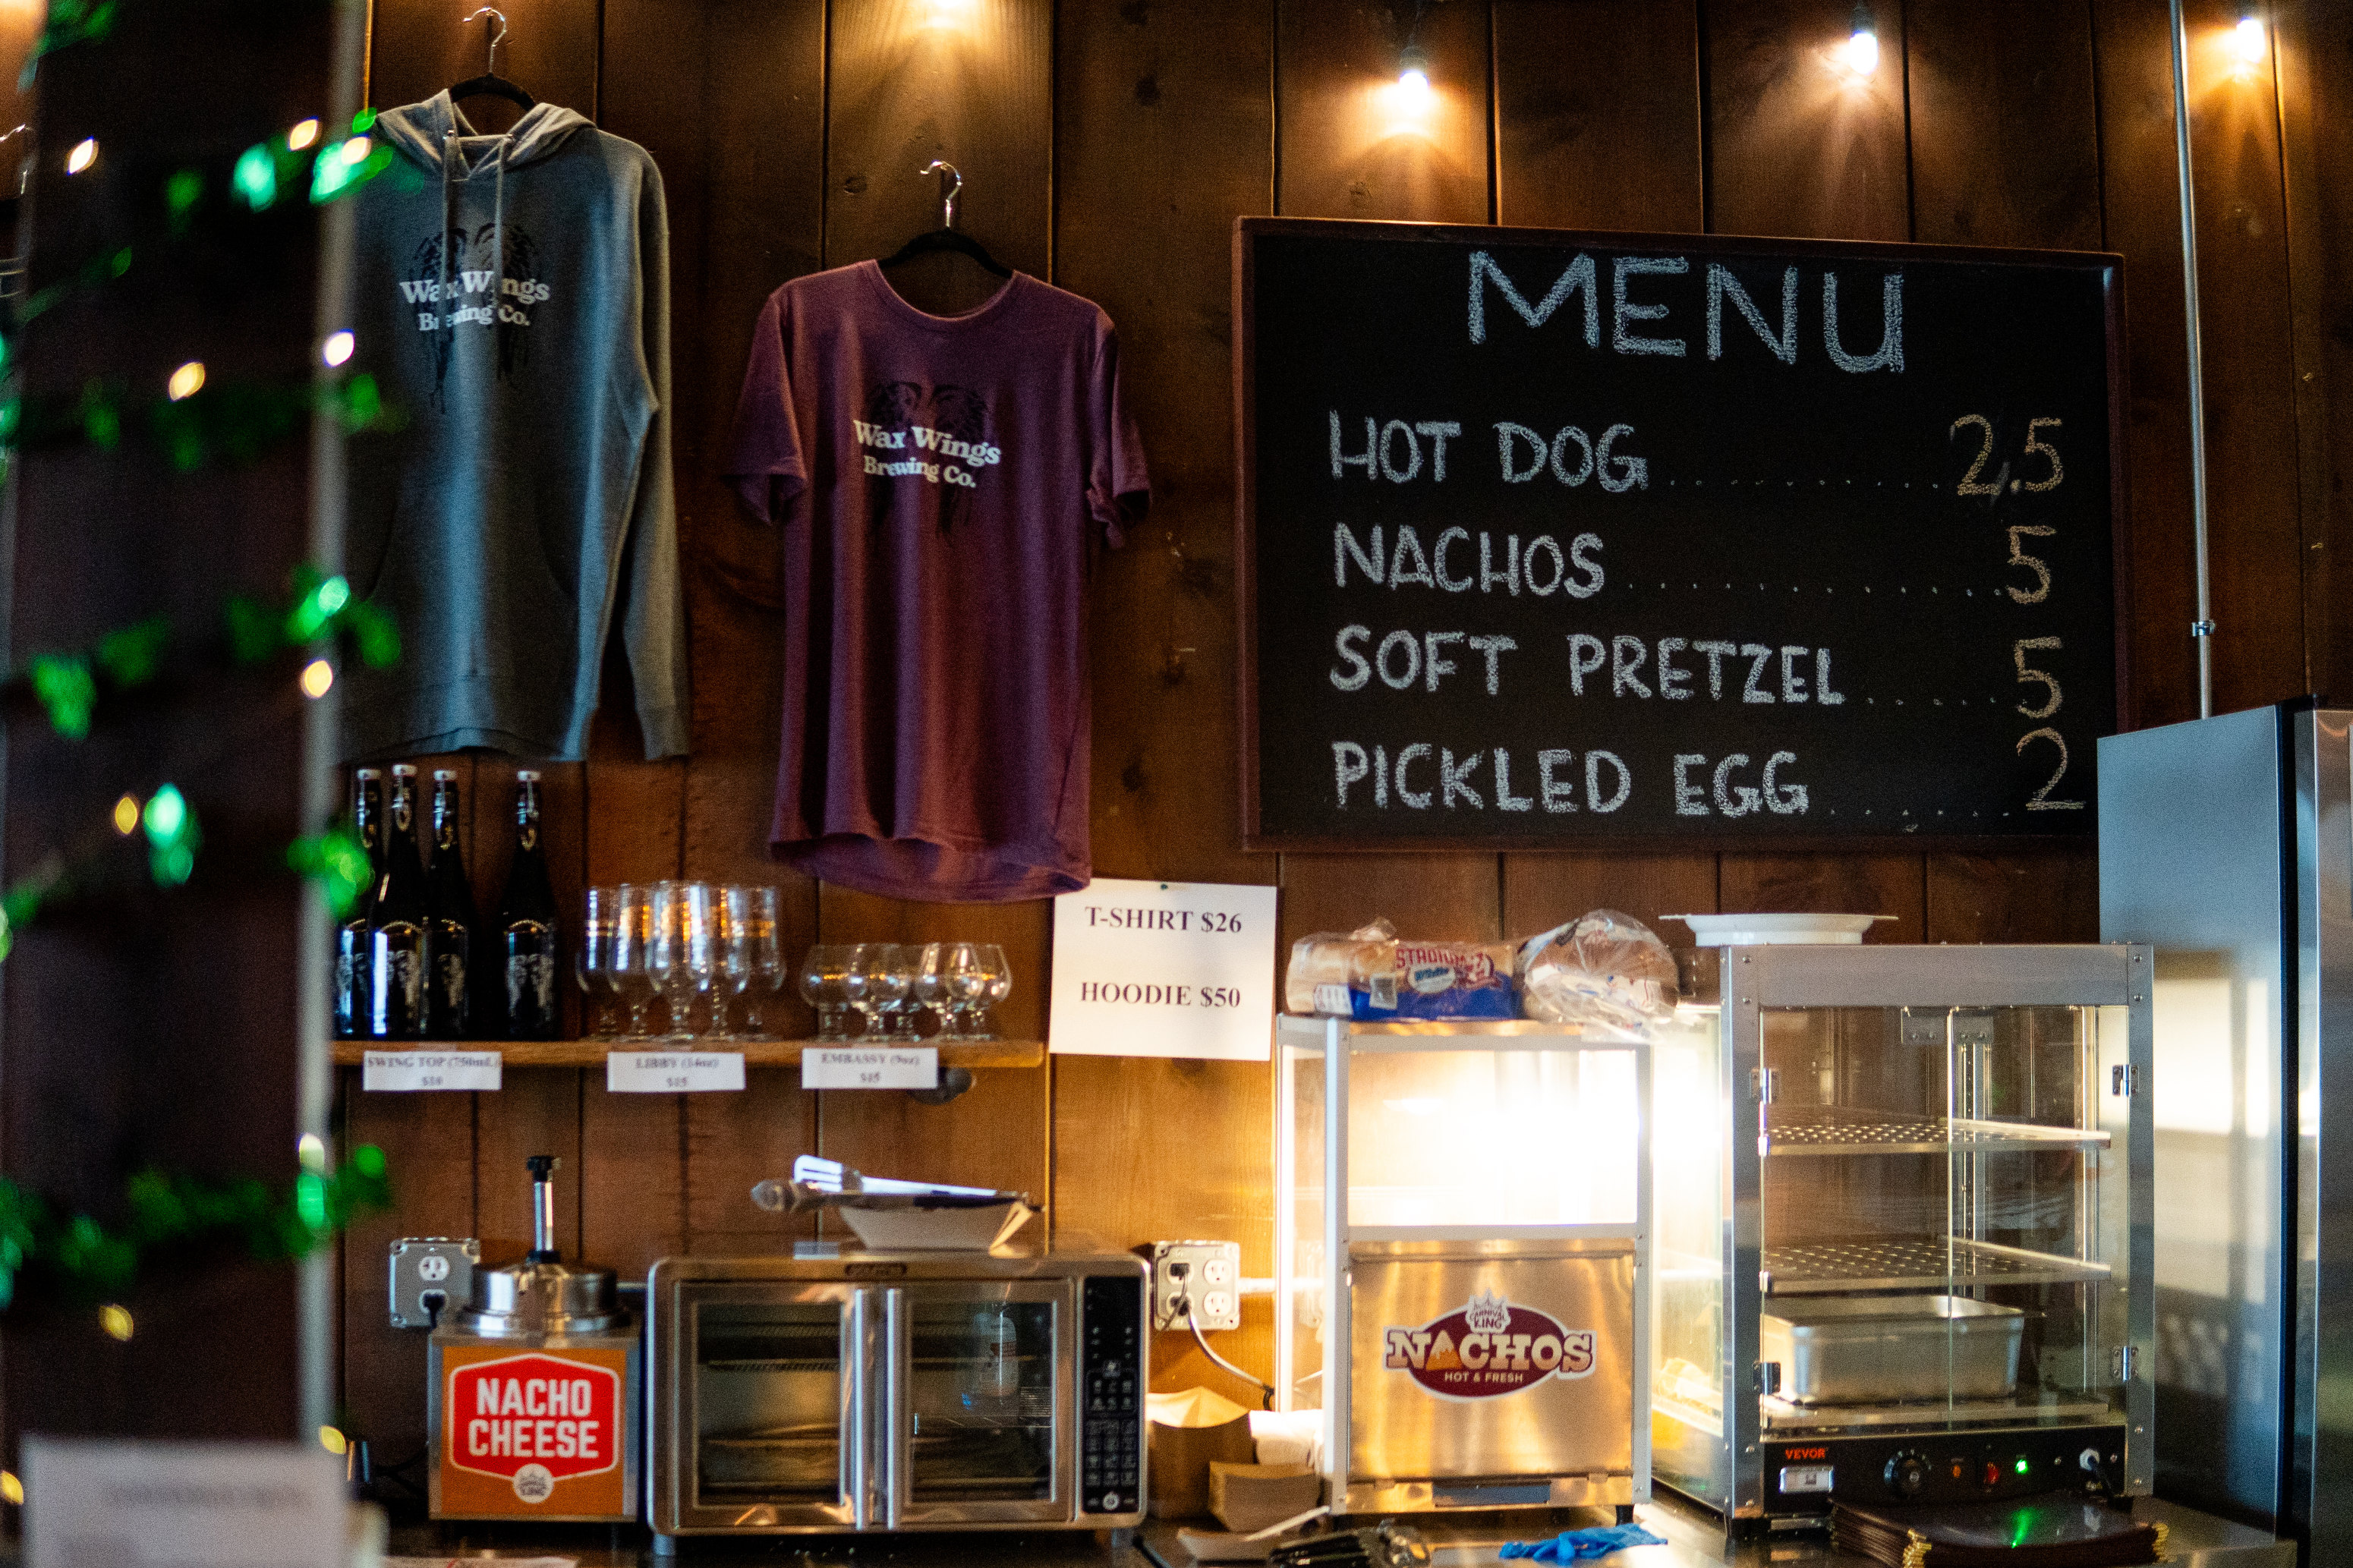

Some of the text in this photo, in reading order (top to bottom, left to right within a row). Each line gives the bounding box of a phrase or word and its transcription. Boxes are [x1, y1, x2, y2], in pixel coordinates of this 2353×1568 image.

[399, 270, 551, 304] Wax Wngs
[498, 304, 531, 326] Co.
[1468, 250, 1904, 373] MENU
[853, 420, 1001, 468] Wax Wings
[1329, 410, 1460, 483] HOT
[1495, 421, 1648, 493] DOG
[943, 465, 976, 488] Co.
[1334, 522, 2056, 606] NACHOS 5
[1329, 624, 2063, 720] SOFT PRETZEL 5
[1331, 726, 2087, 818] PICKLED EGG 2
[1084, 905, 1243, 934] T-SHIRT $26
[1080, 981, 1242, 1009] HOODIE $50
[418, 1057, 446, 1068] TOP
[1474, 1318, 1502, 1329] KING
[1386, 1330, 1594, 1374] NACHOS
[1444, 1371, 1523, 1384] HOT & FRESH
[476, 1378, 593, 1417] NACHO
[468, 1418, 600, 1459] CHEESE
[1785, 1447, 1826, 1460] VEVOR
